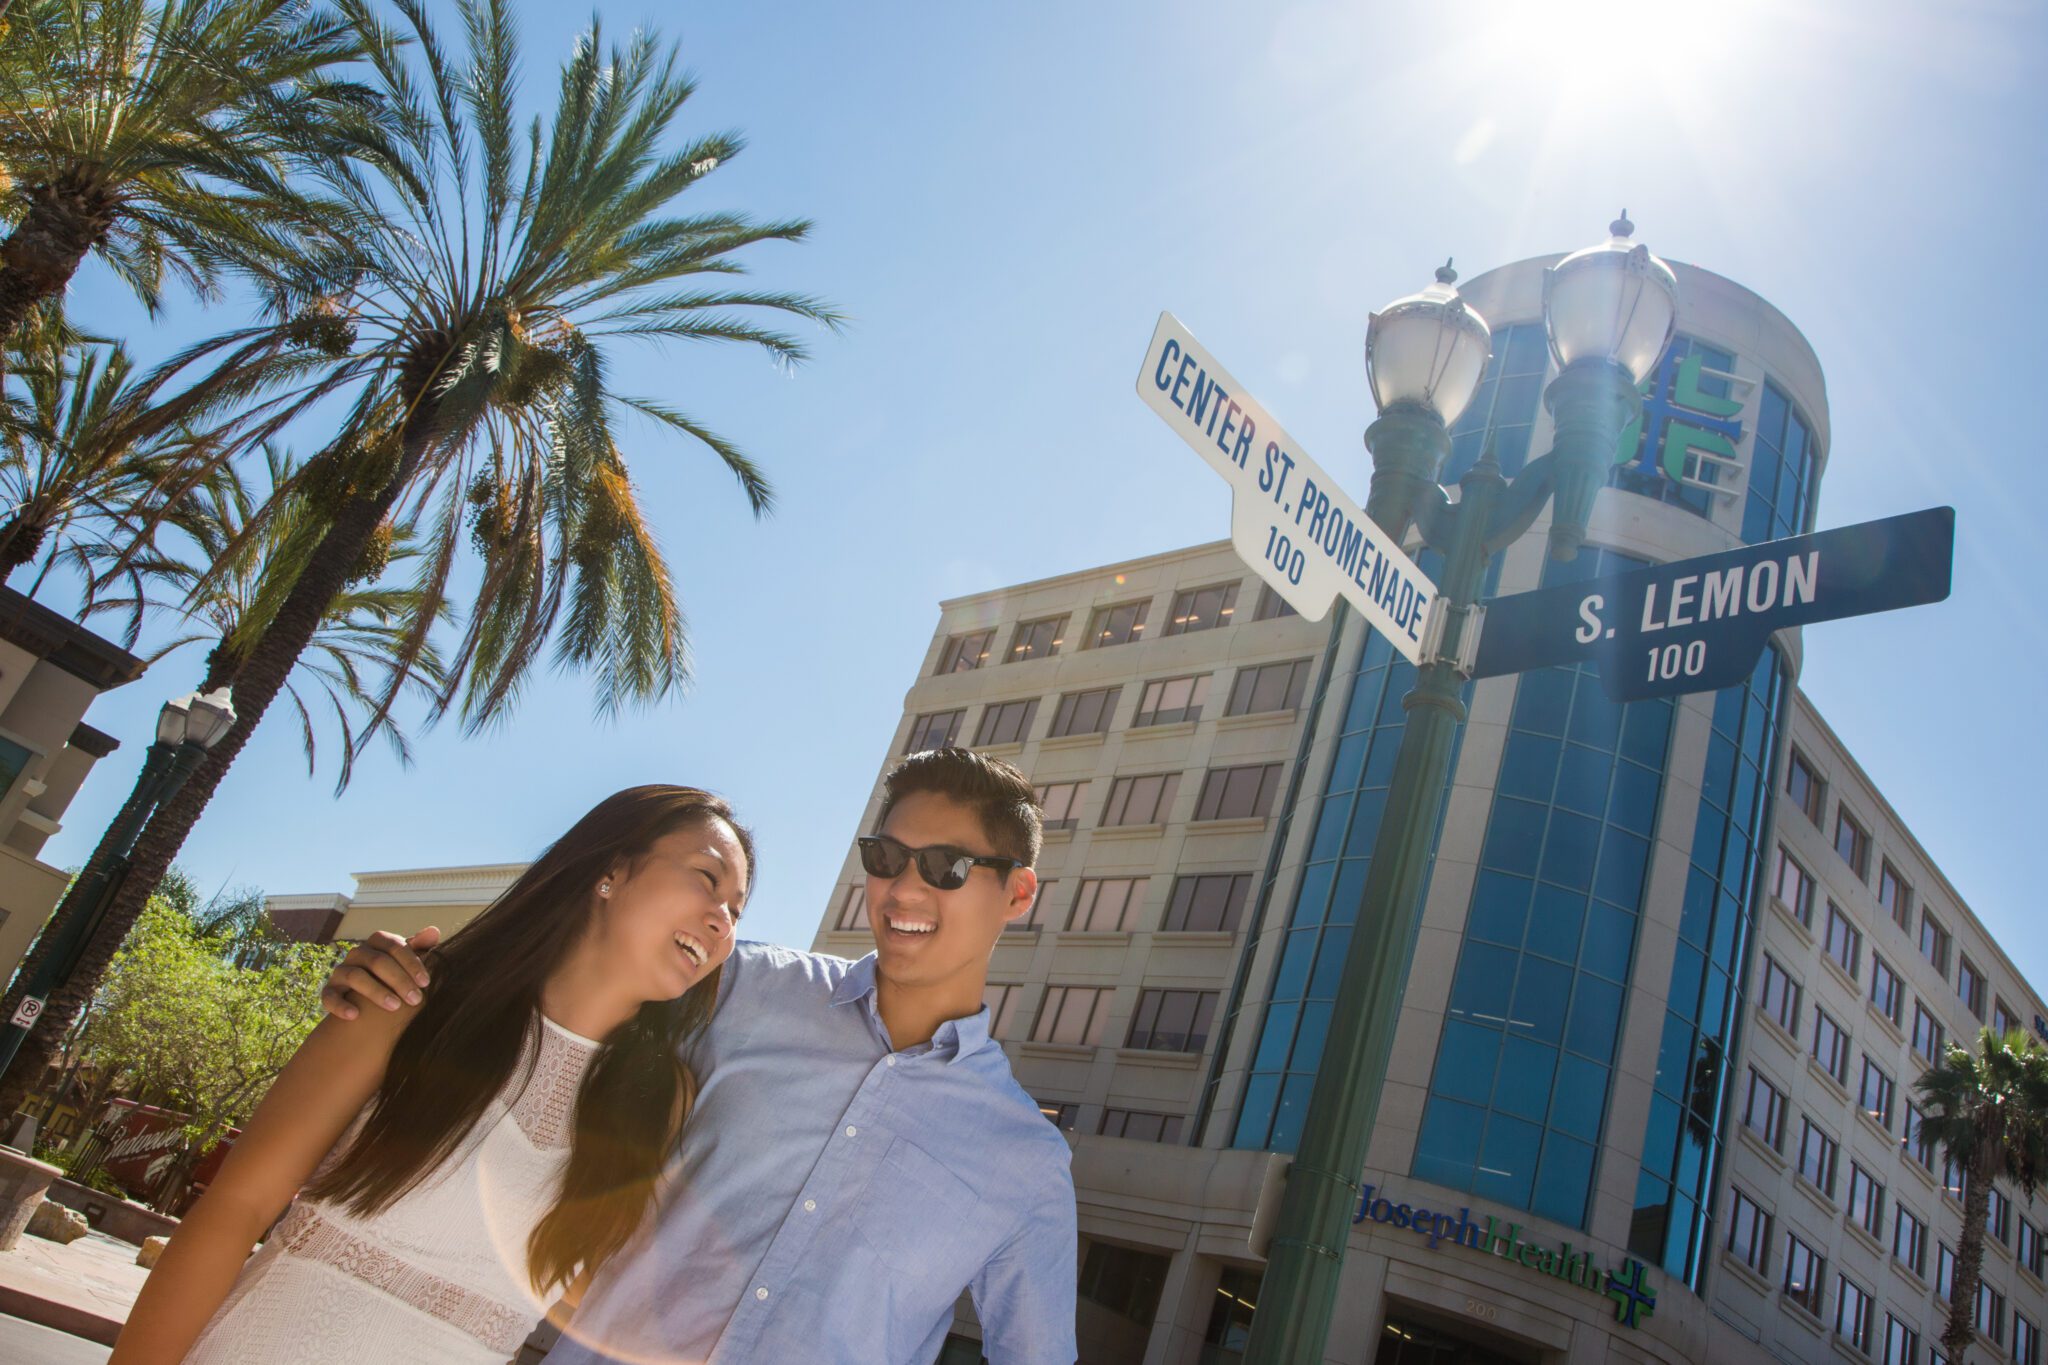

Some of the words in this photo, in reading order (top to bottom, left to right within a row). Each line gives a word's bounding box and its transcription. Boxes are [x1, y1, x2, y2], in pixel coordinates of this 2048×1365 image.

[1155, 339, 1256, 470] CENTER
[1258, 441, 1296, 514] ST.
[1295, 478, 1427, 643] PROMENADE
[1265, 525, 1306, 587] 100
[1575, 594, 1616, 644] S.
[1640, 551, 1820, 632] LEMON
[1647, 640, 1707, 682] 100
